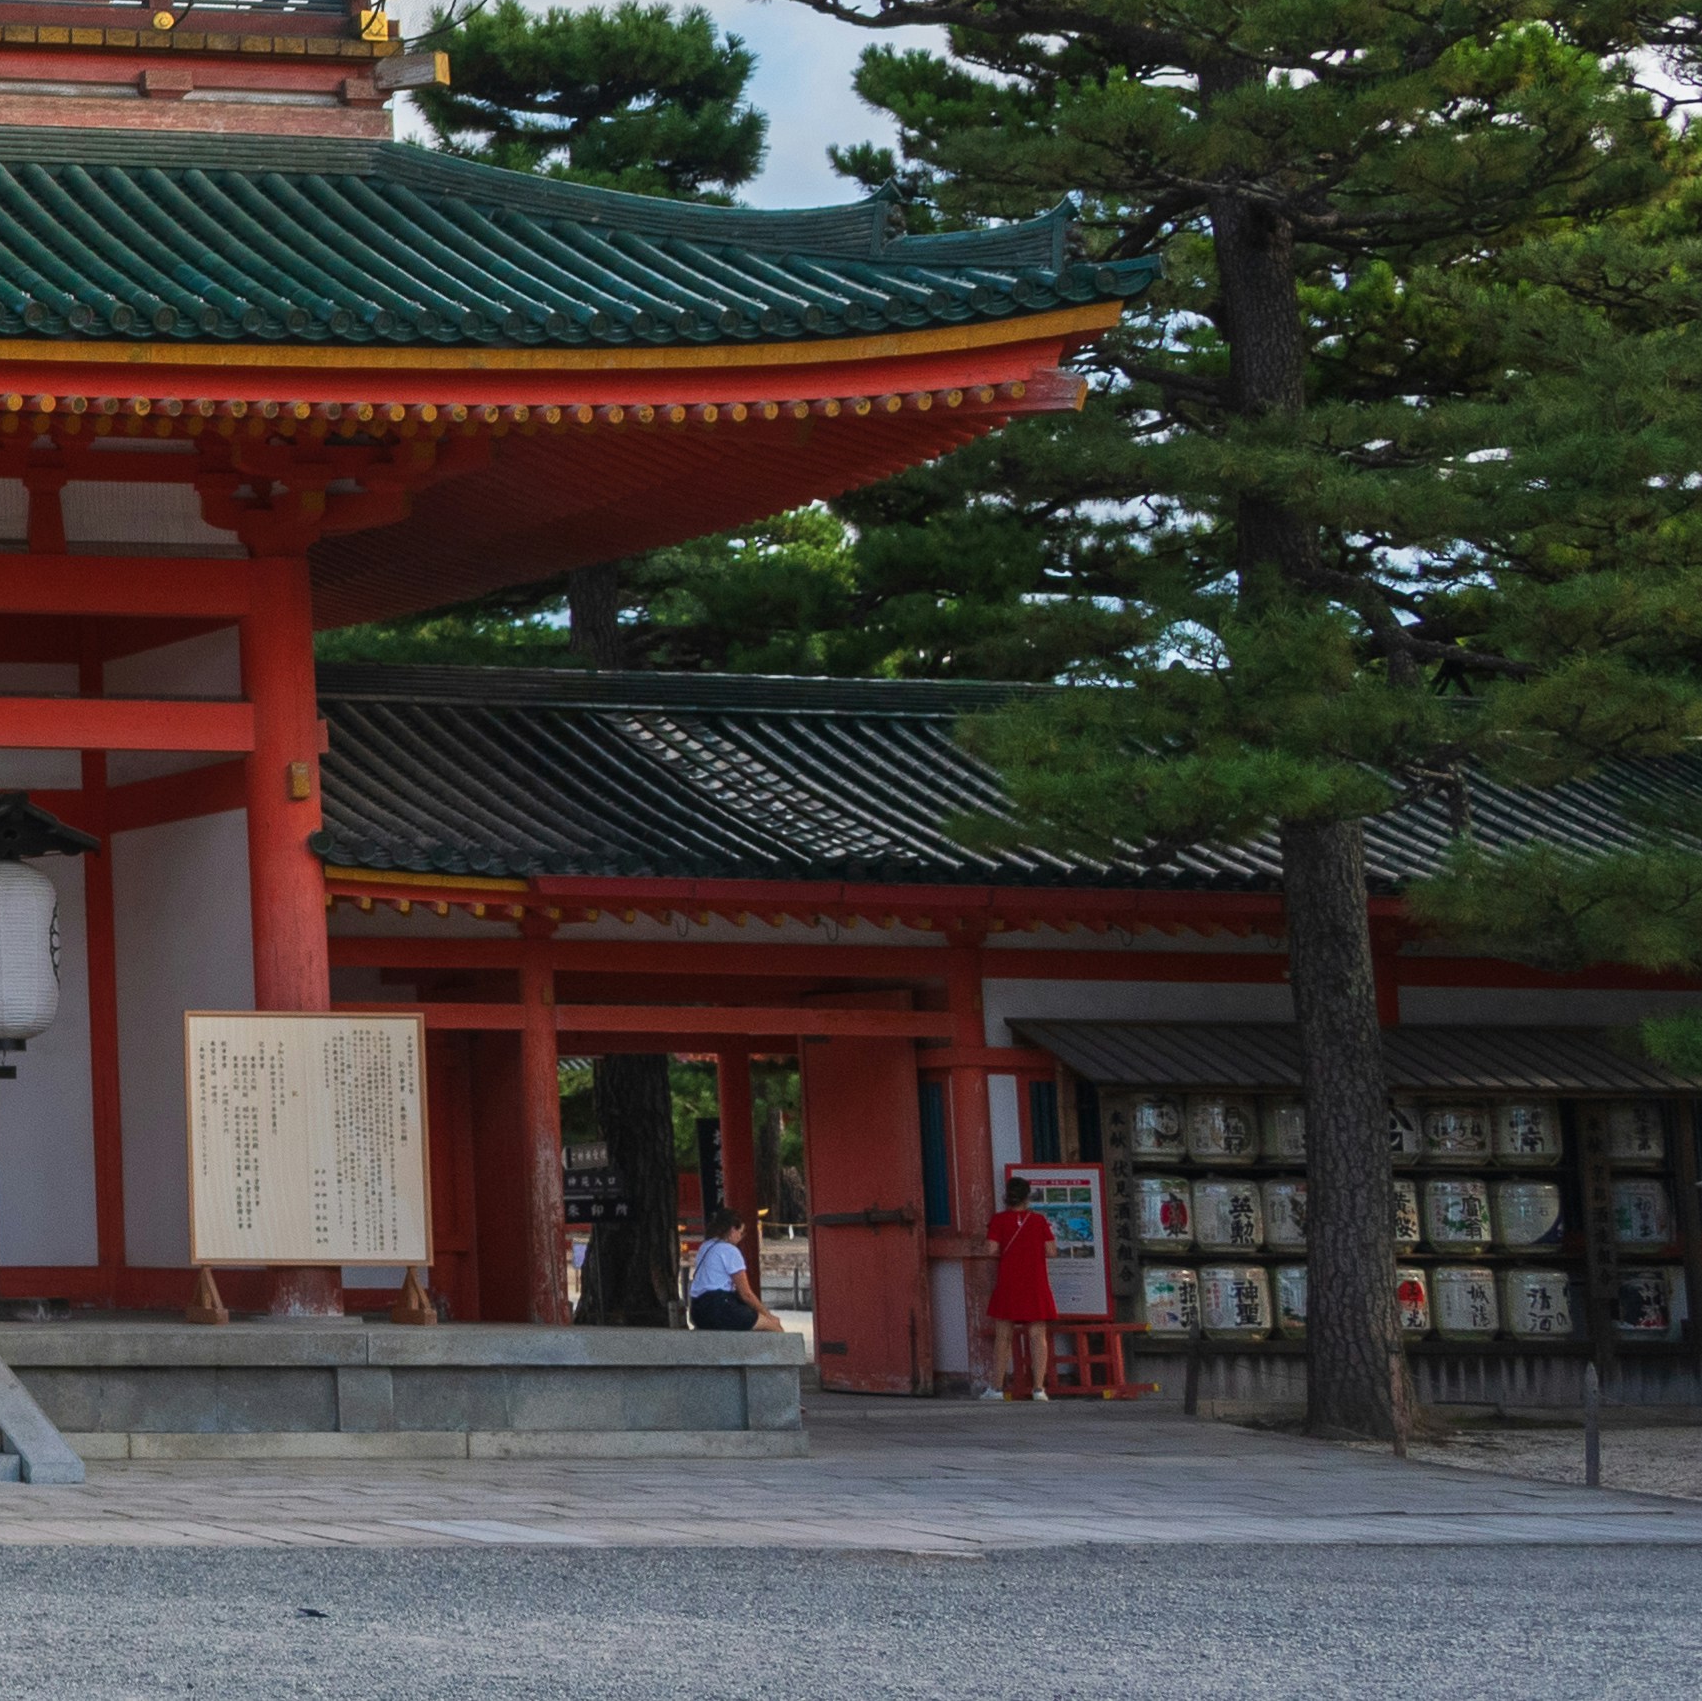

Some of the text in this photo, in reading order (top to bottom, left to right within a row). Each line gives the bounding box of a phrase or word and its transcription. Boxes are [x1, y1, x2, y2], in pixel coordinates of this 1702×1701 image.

[1229, 1194, 1255, 1245] 英勲
[1231, 1281, 1262, 1327] 神聖
[1526, 1286, 1554, 1332] 清酒
